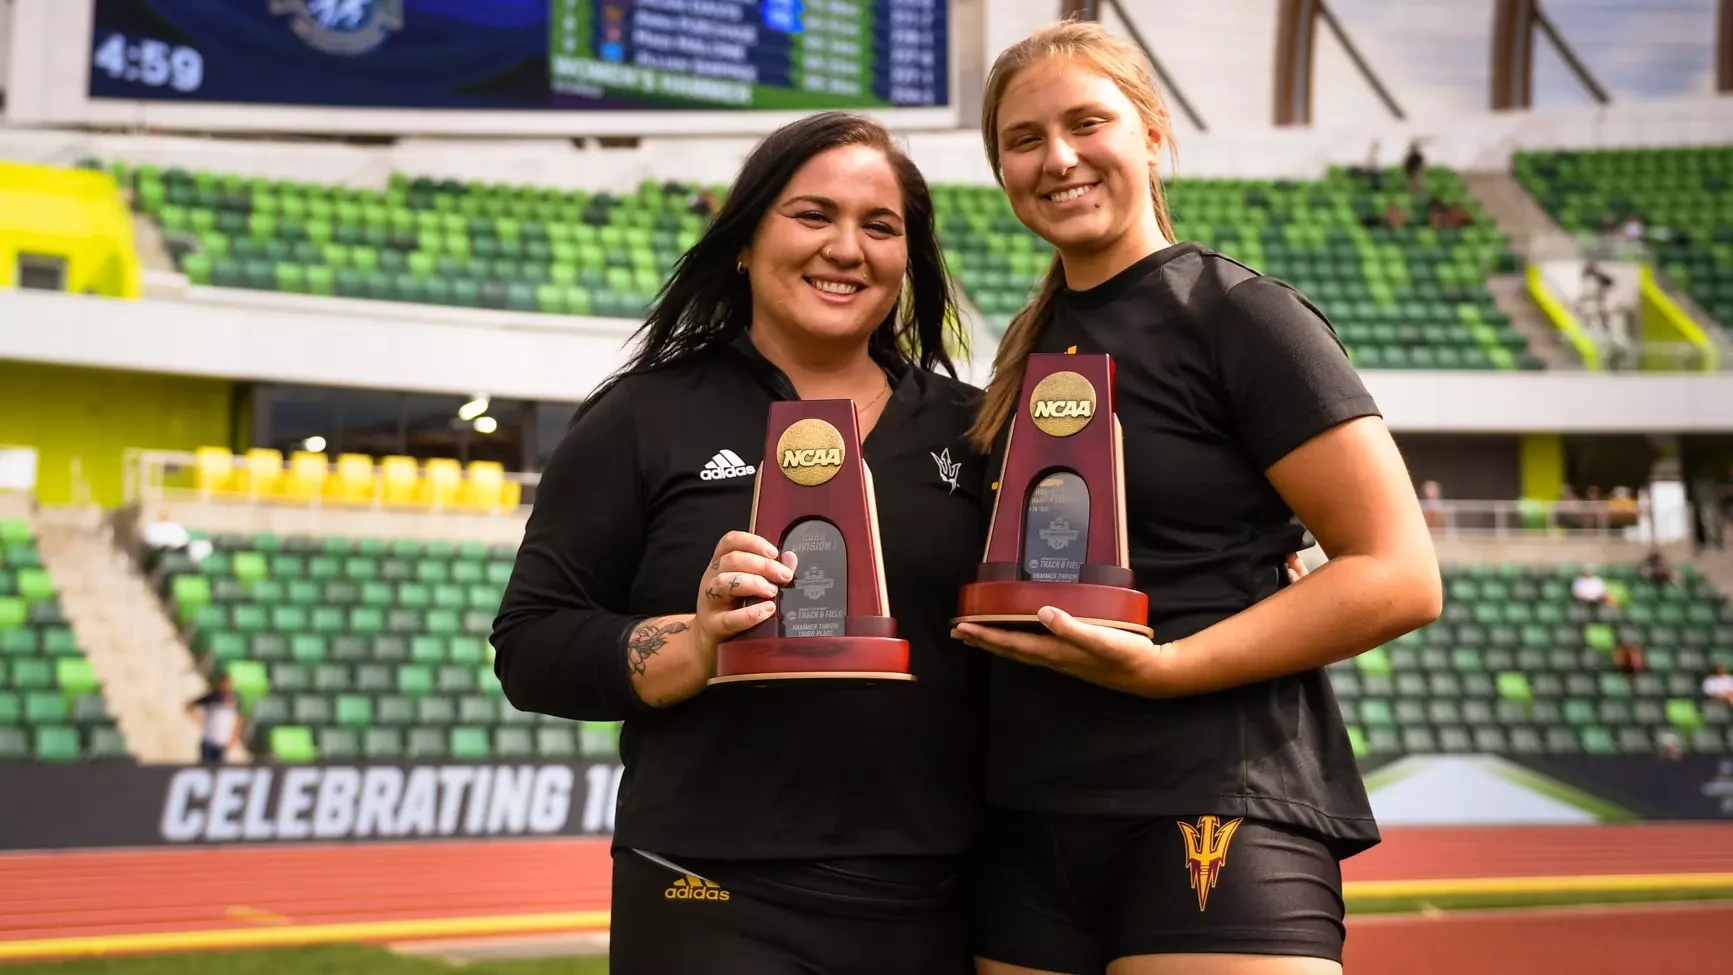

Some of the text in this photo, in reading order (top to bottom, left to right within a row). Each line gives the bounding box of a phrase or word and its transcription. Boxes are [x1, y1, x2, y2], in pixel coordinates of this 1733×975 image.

[95, 33, 204, 92] 4:59
[1034, 400, 1091, 418] NCAA
[783, 448, 840, 467] NCAA
[700, 465, 756, 480] adidas
[792, 540, 832, 551] DIVISION
[1040, 560, 1060, 569] TRACK
[798, 610, 819, 620] TRACK
[825, 609, 843, 619] FIELD
[161, 765, 574, 841] CELEBRATING
[665, 885, 730, 901] adidas
